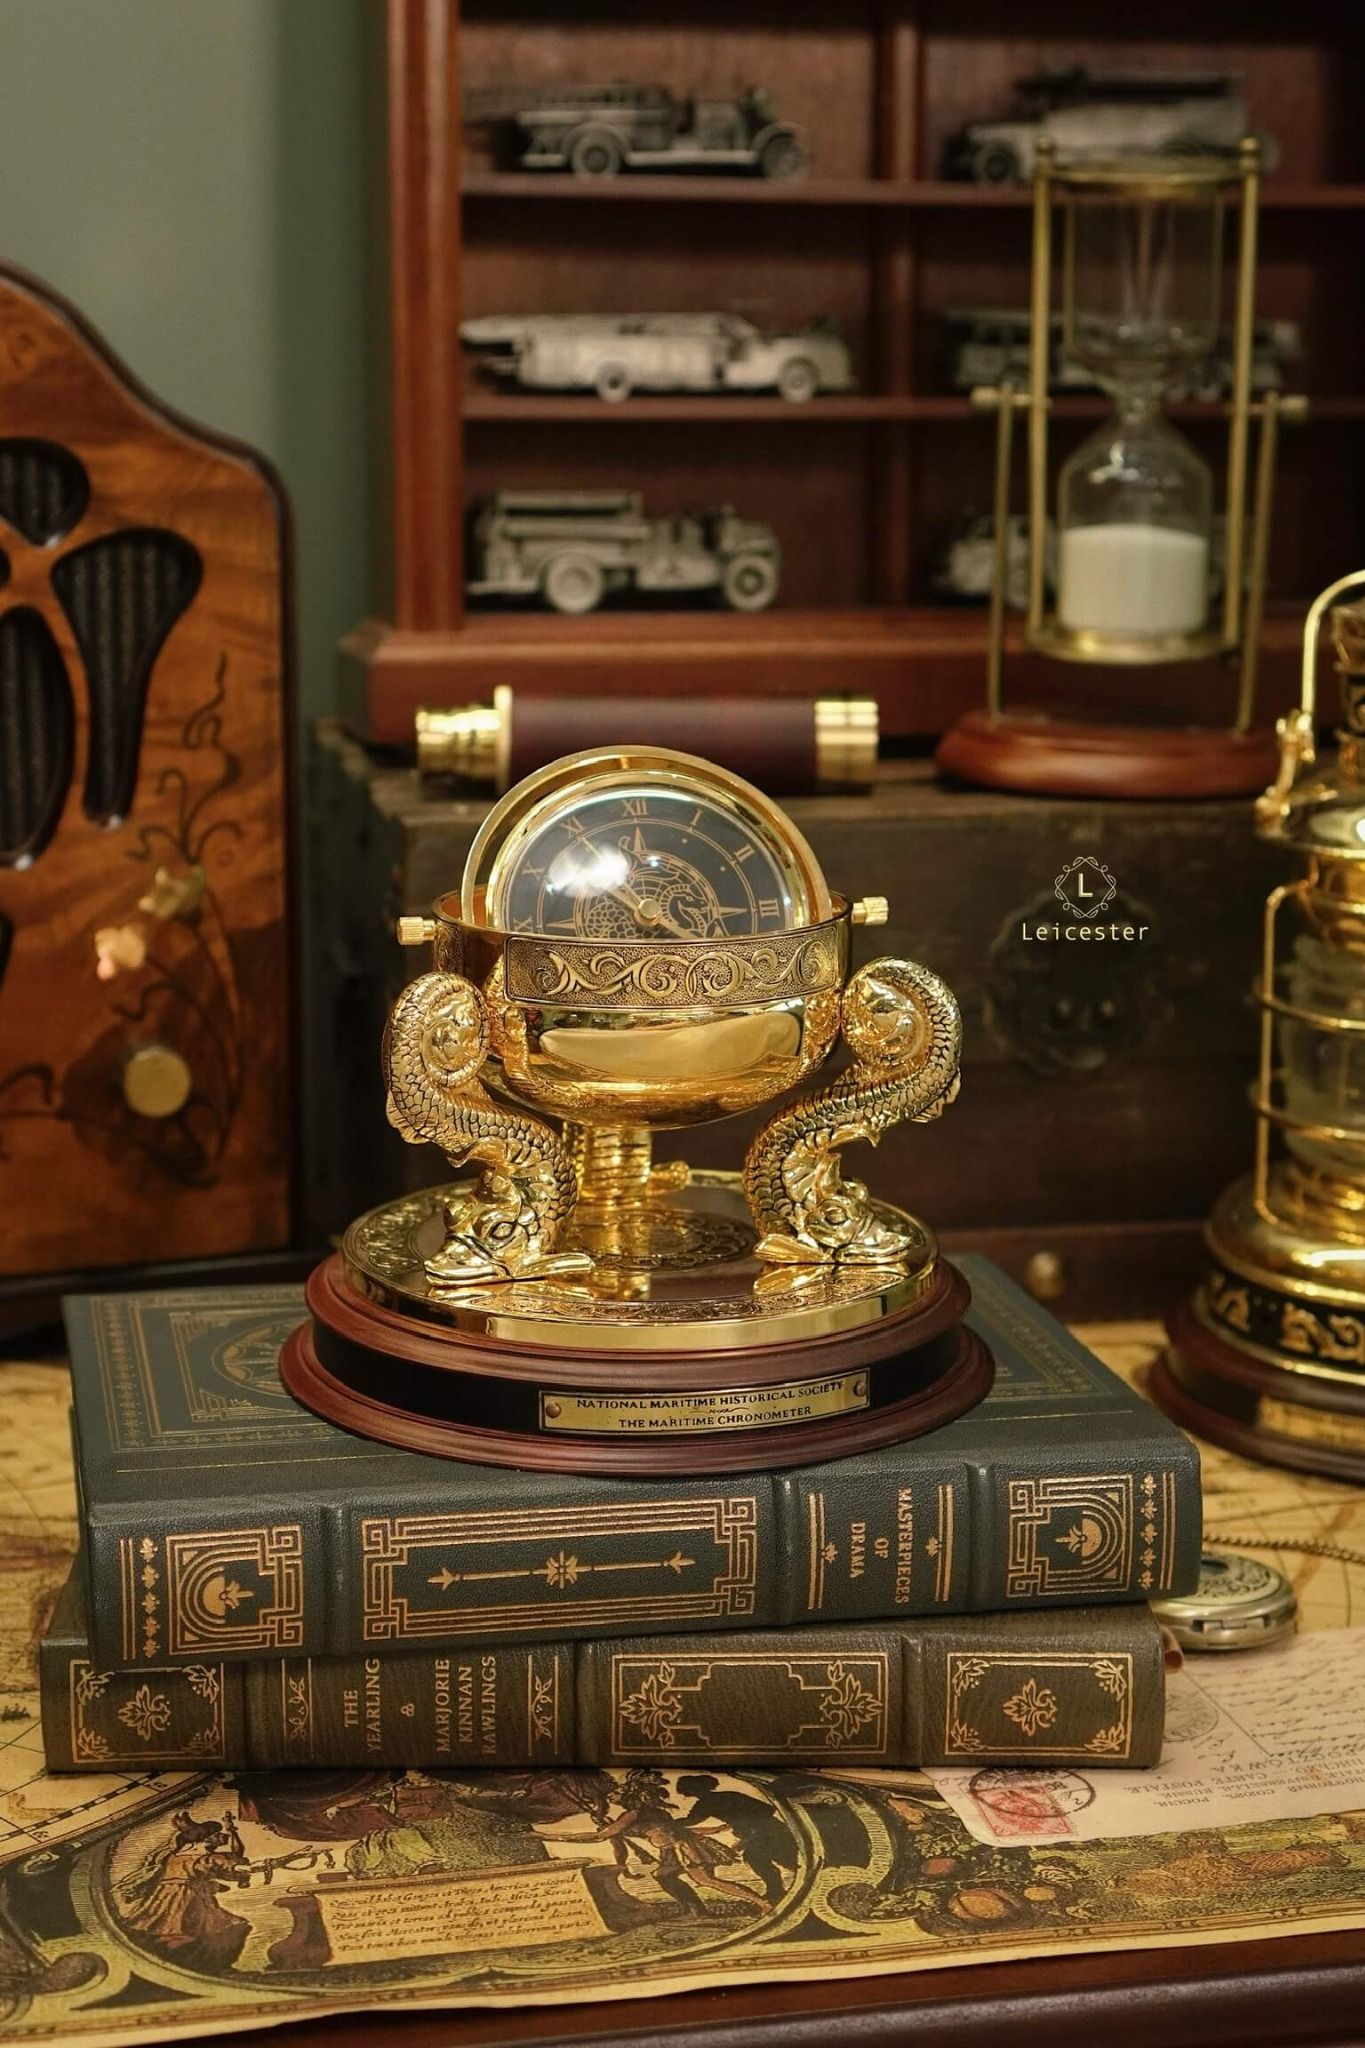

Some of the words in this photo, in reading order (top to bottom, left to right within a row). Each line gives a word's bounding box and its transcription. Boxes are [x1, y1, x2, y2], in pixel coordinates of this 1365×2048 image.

[621, 799, 649, 817] XII
[690, 808, 703, 826] I
[560, 815, 586, 840] XI
[733, 843, 756, 864] II
[758, 897, 780, 919] III
[576, 1399, 647, 1410] NATIONAL
[649, 1397, 716, 1409] MARITIME
[719, 1390, 796, 1406] HISTORICAL
[798, 1380, 844, 1397] SOCIETY
[618, 1418, 646, 1429] THE
[648, 1416, 715, 1429] MARITIME
[717, 1406, 812, 1425] CHRONOMETER
[850, 1521, 866, 1579] DRAMA
[874, 1537, 890, 1559] OF
[895, 1487, 914, 1604] MASTERPIECES
[344, 1689, 358, 1728] THE
[365, 1657, 381, 1753] YEARLING
[434, 1658, 451, 1752] MARJORIE
[458, 1665, 473, 1744] KINNAN
[481, 1655, 497, 1755] RAWLINGS
